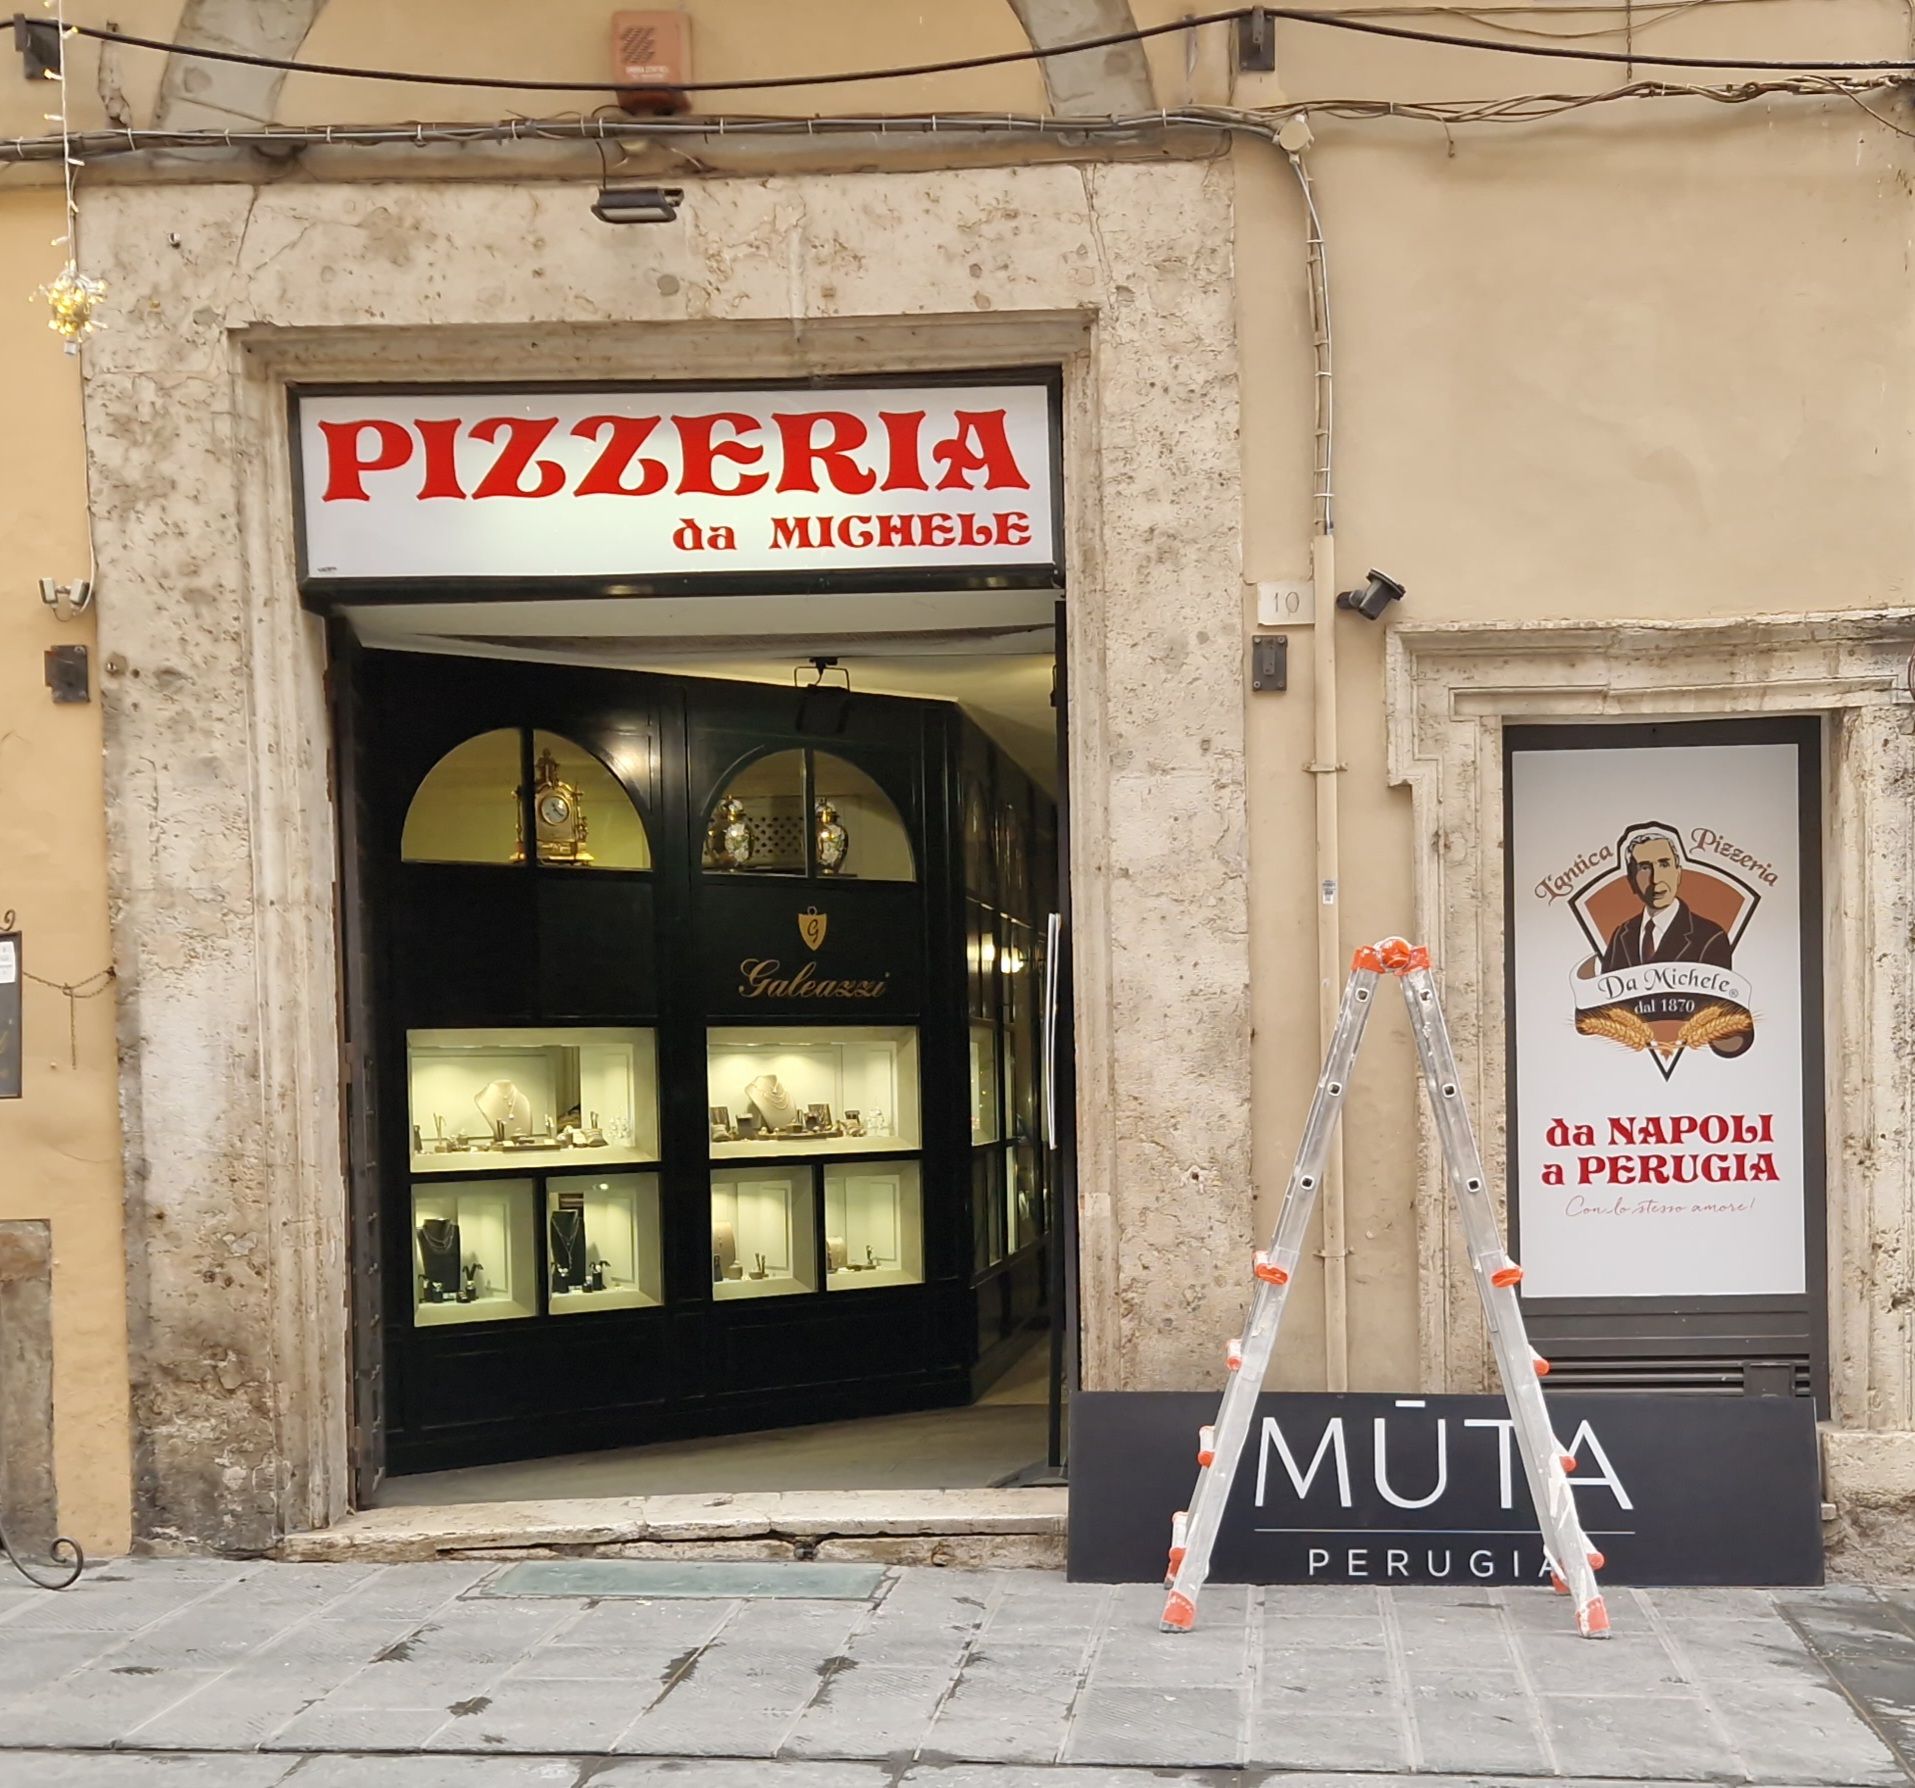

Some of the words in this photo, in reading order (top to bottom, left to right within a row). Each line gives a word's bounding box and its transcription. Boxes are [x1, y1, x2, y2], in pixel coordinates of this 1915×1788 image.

[319, 409, 1031, 502] PIZZERIA
[673, 518, 737, 551] da
[769, 511, 1032, 550] MICHELE
[1273, 591, 1300, 614] 10
[1689, 827, 1778, 887] Pizzeria
[738, 958, 891, 998] Galeazzi
[1598, 975, 1638, 1000] Da
[1634, 1001, 1656, 1015] dal
[1661, 998, 1696, 1013] 1870
[1546, 1118, 1595, 1147] da
[1608, 1114, 1774, 1145] NAPOLI
[1541, 1163, 1565, 1185] a
[1578, 1153, 1780, 1185] PERUGIA
[1565, 1195, 1605, 1217] Con
[1609, 1197, 1631, 1216] lo
[1632, 1199, 1688, 1215] stesso
[1691, 1197, 1756, 1213] amore!
